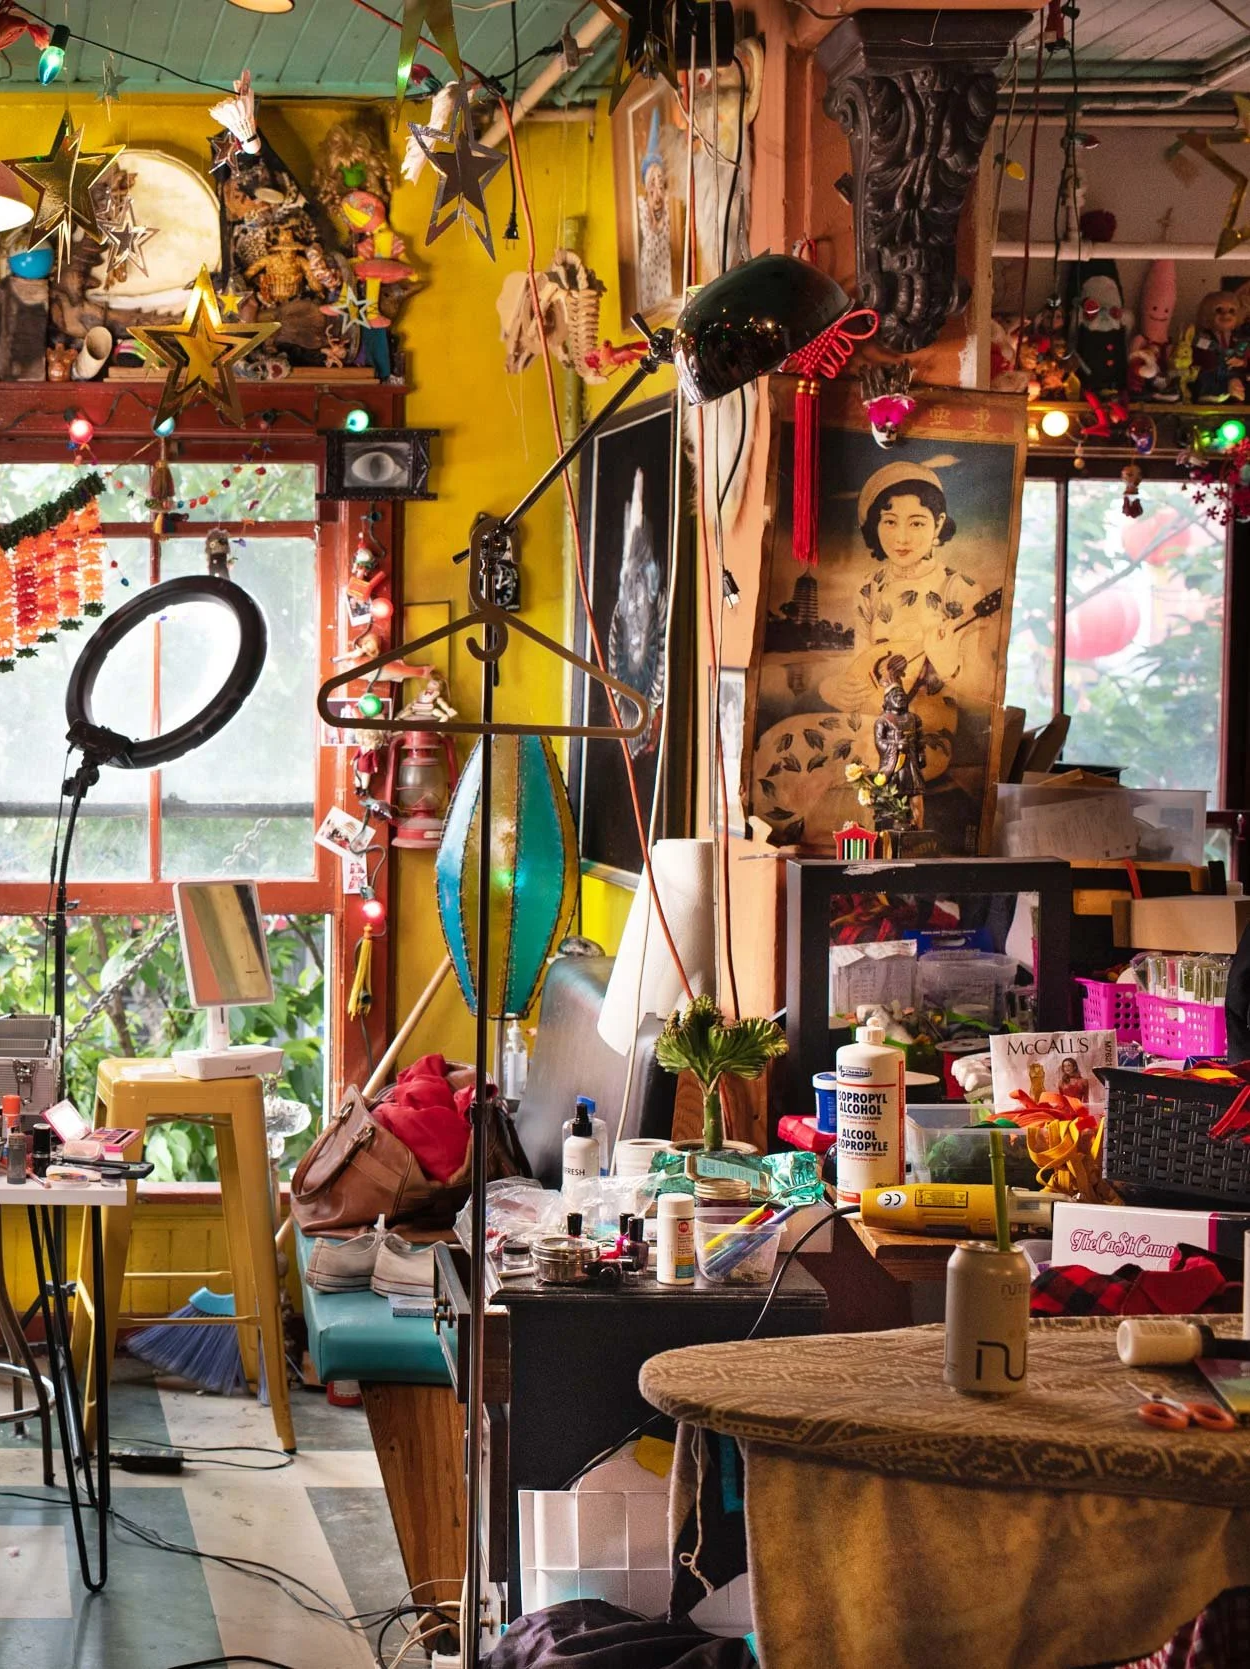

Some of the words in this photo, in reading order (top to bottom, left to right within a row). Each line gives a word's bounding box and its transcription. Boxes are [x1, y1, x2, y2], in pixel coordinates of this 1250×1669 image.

[1007, 1037, 1089, 1056] McCALL'S
[838, 1091, 888, 1104] SOPROPYL
[839, 1101, 883, 1115] ALCOHOL
[842, 1128, 877, 1141] ALCOOL
[838, 1138, 889, 1152] SOPROPYLE
